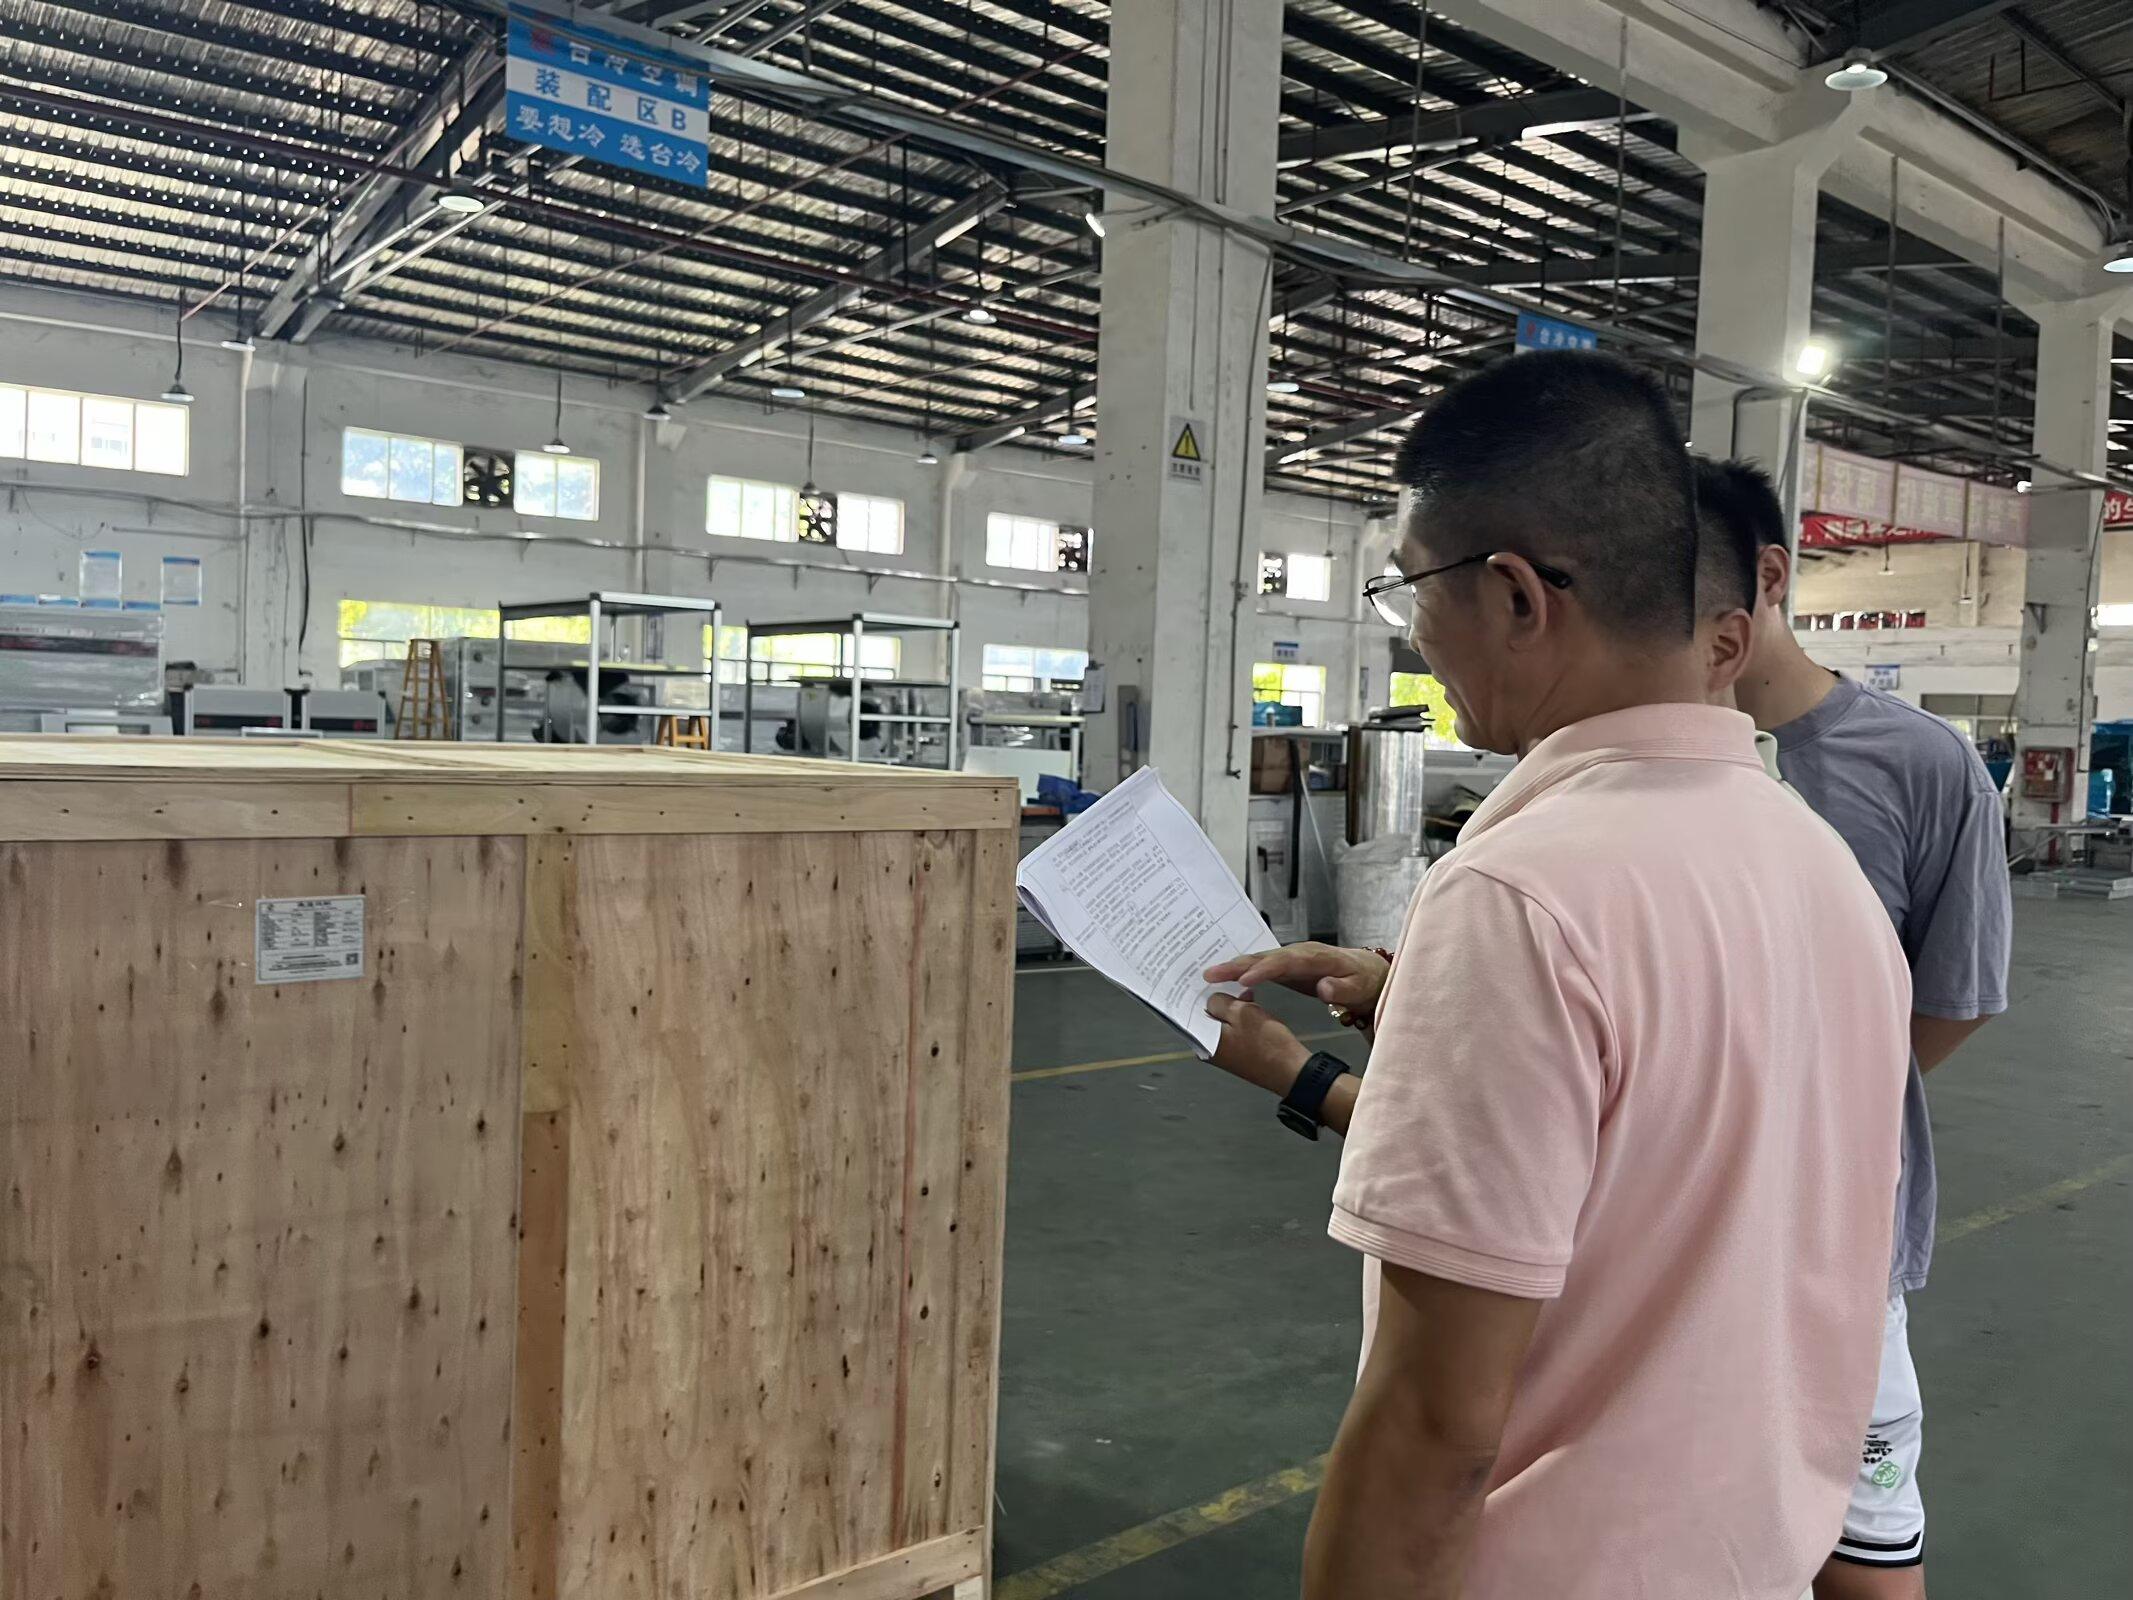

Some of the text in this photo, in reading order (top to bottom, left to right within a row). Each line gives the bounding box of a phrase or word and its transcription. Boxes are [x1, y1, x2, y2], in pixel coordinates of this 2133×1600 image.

[516, 104, 700, 174] 要想冷 选台冷
